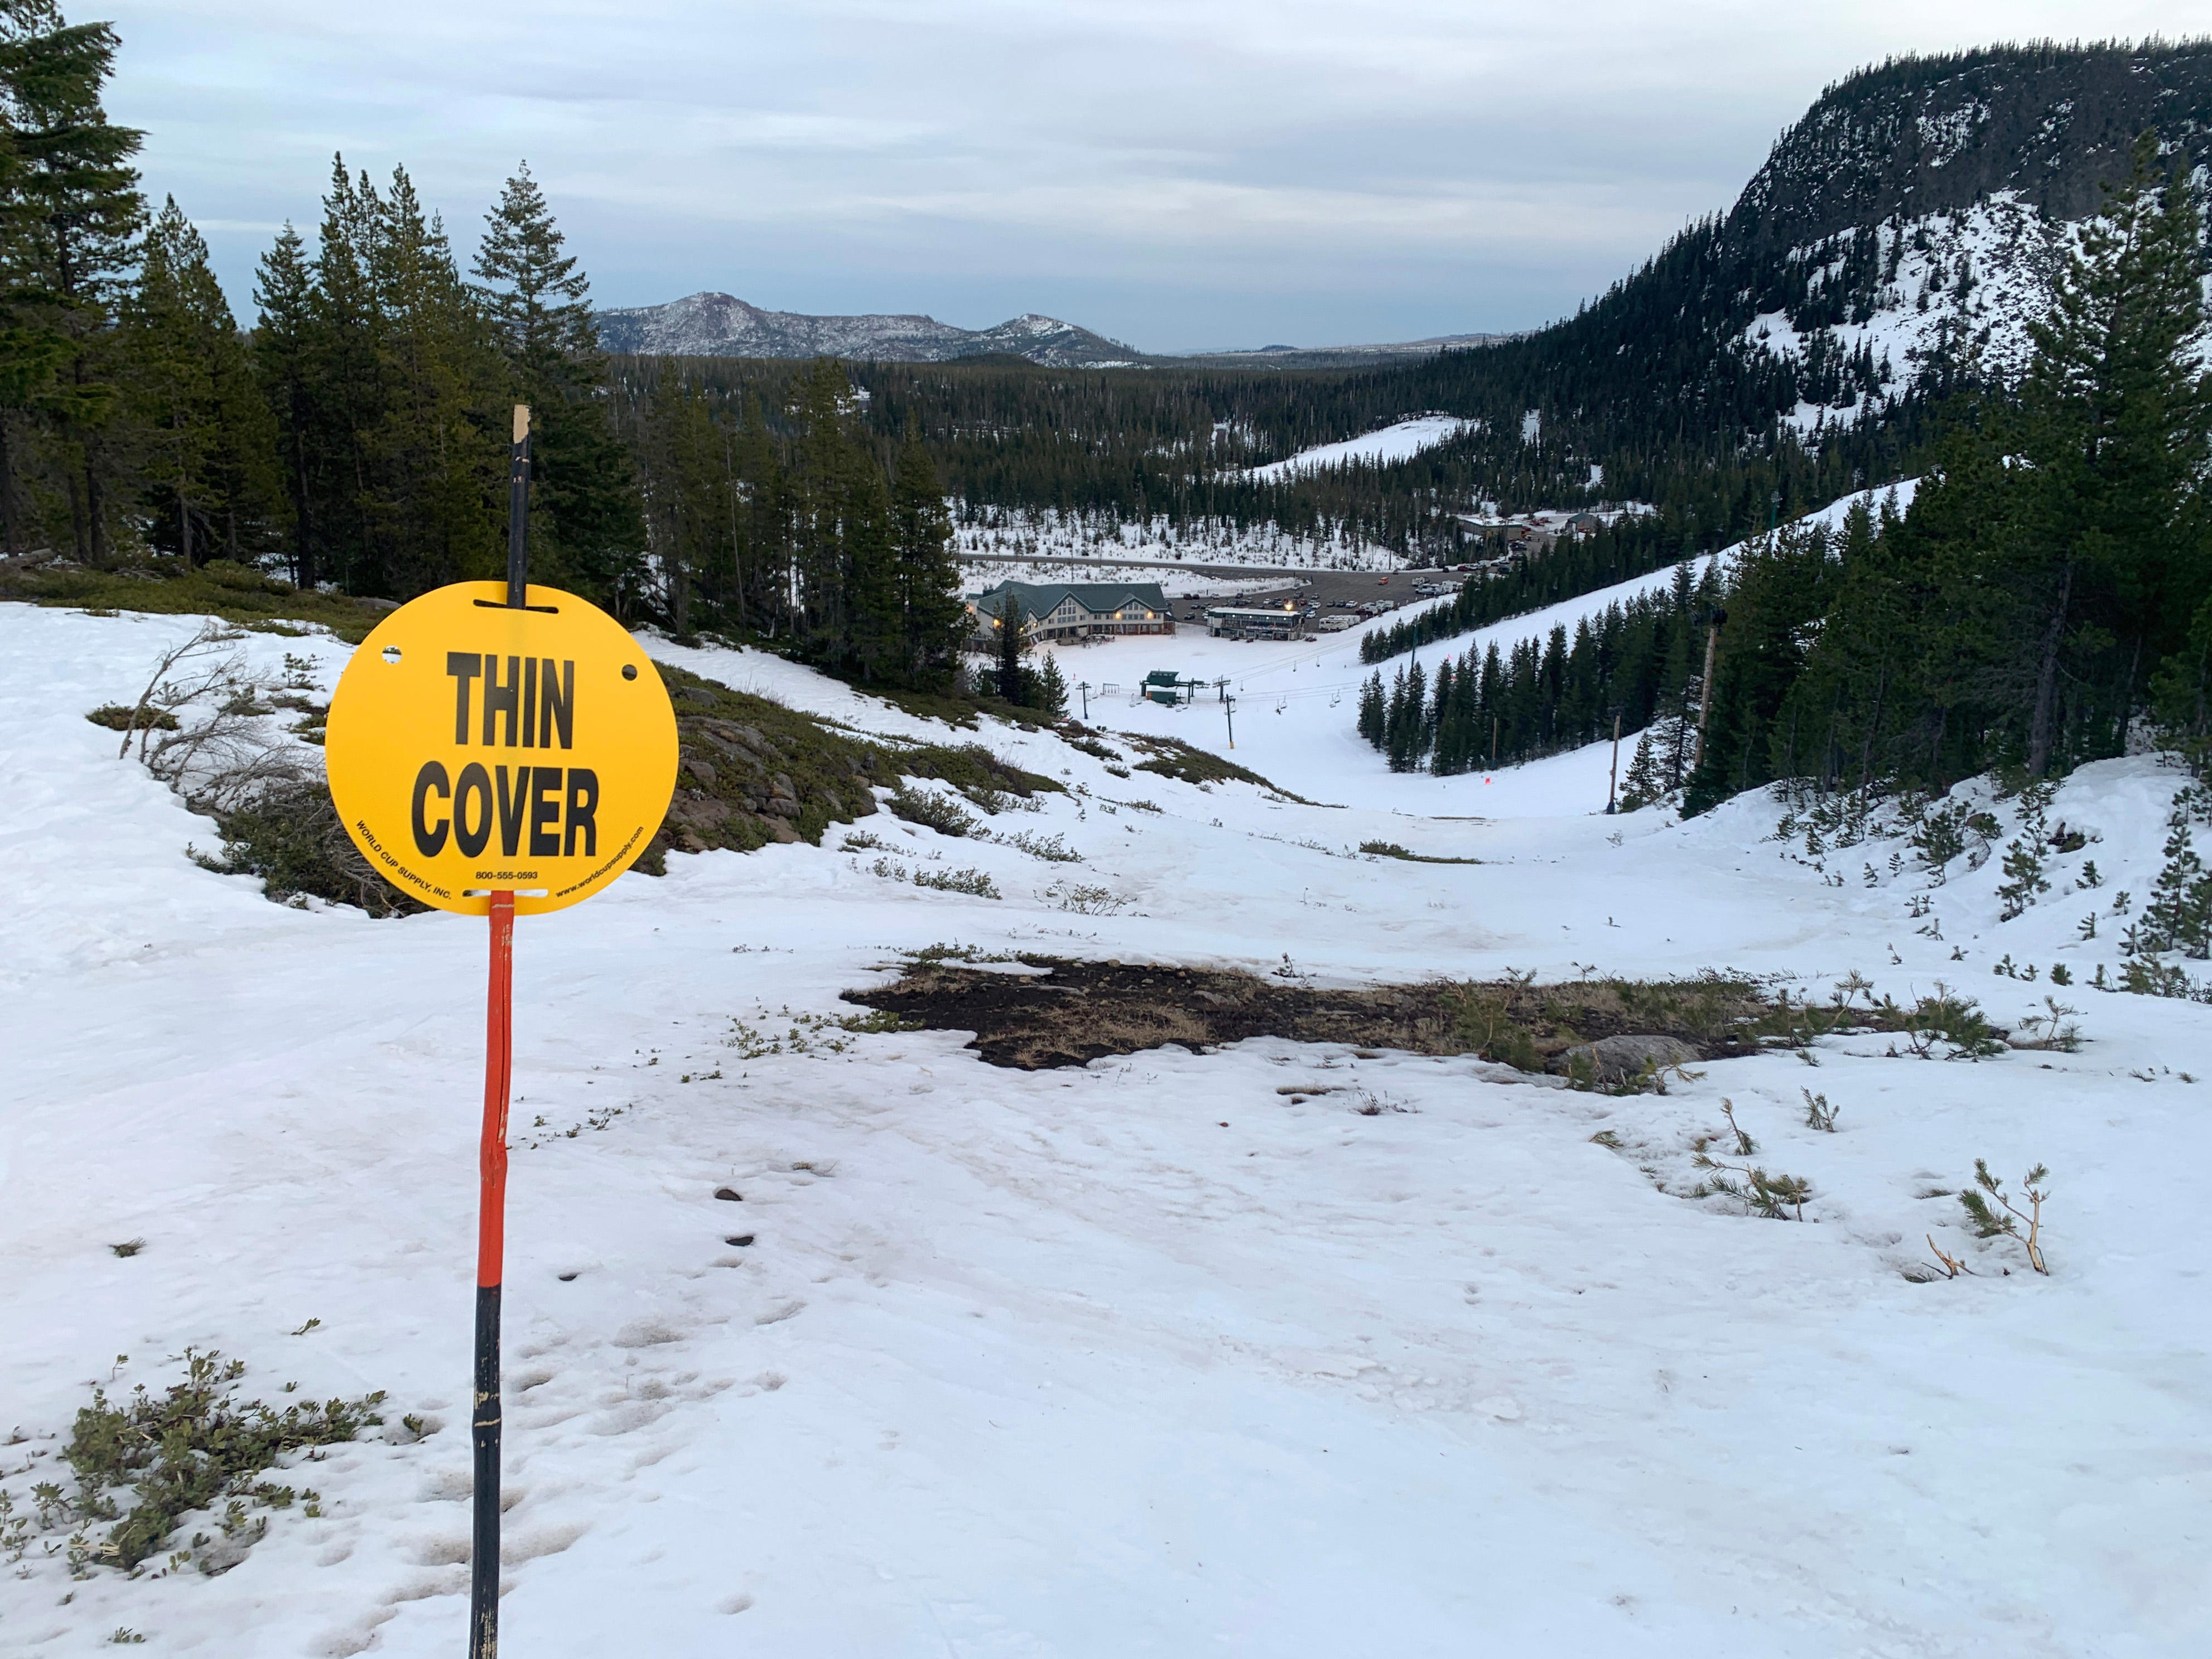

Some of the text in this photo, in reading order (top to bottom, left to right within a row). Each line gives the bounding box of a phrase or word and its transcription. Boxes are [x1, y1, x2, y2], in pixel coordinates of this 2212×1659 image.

[447, 652, 574, 749] THIN
[411, 761, 599, 858] COVER
[356, 820, 451, 899] WORLD CUP SUPPLY, INC.
[476, 871, 538, 880] 800-555-0593
[556, 827, 644, 897] www.worldcupsupply.com
